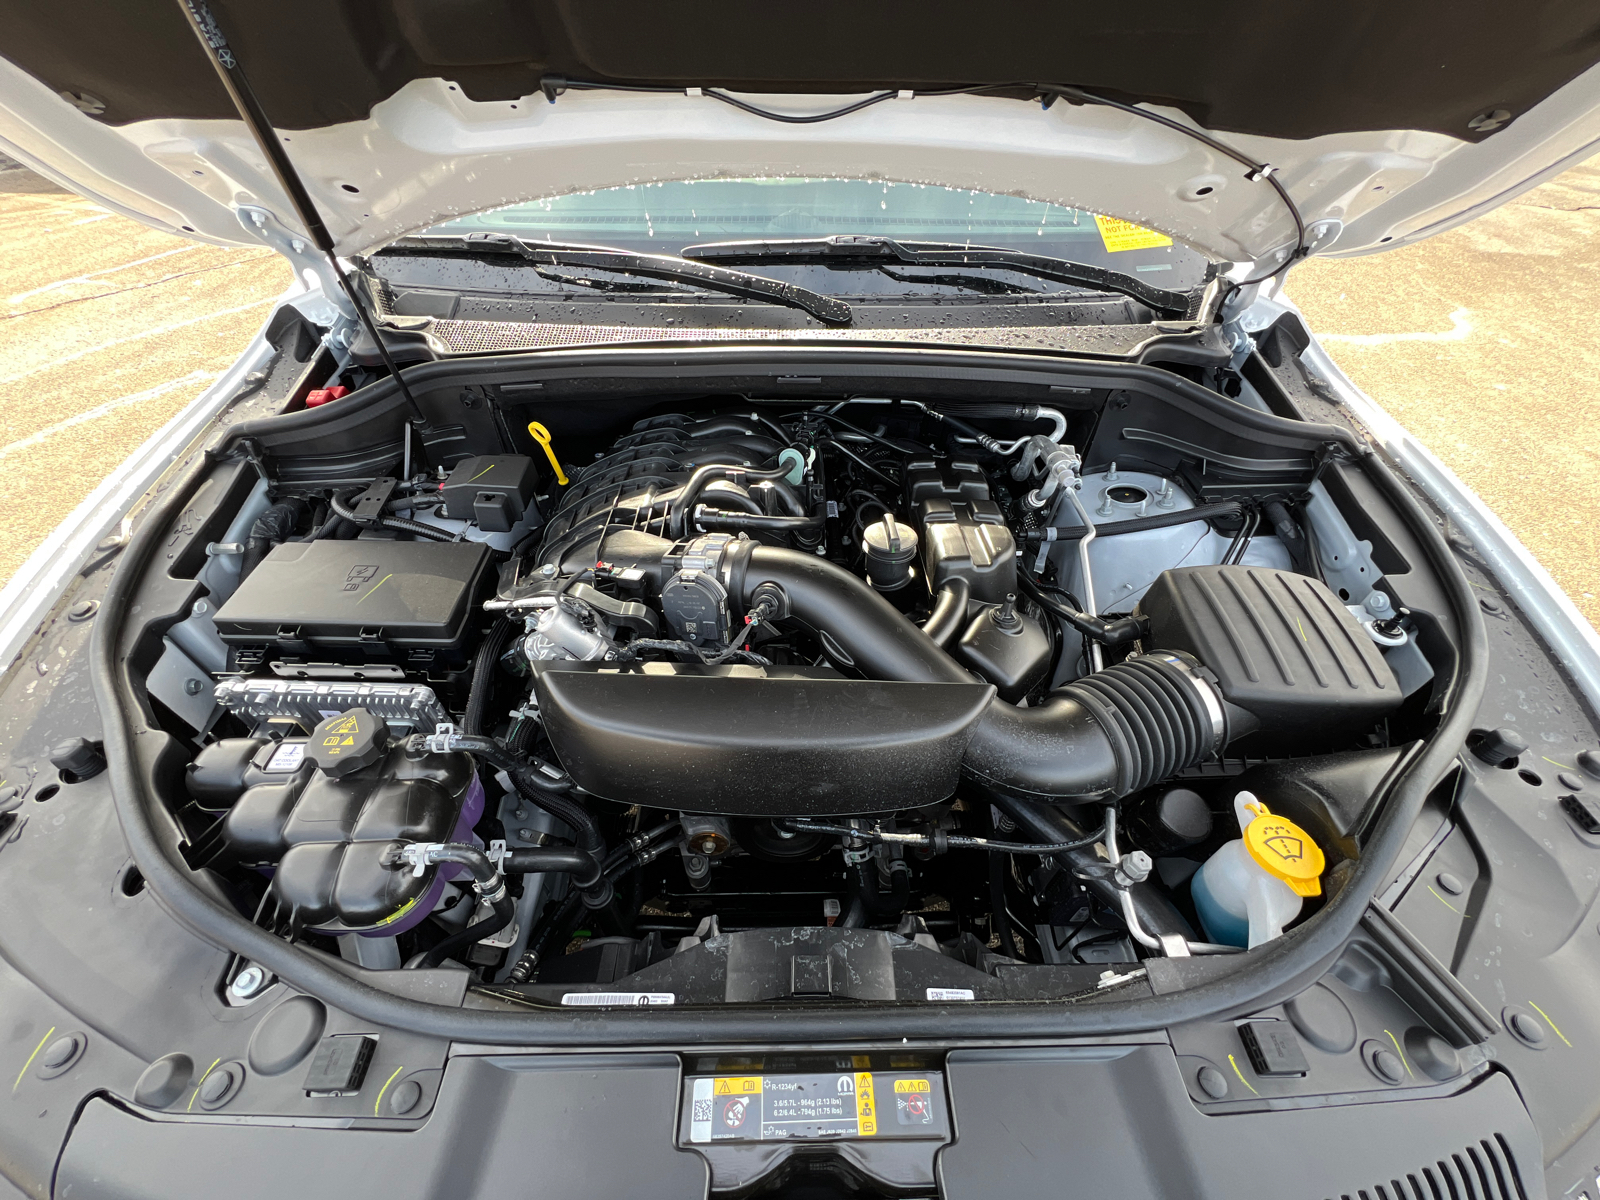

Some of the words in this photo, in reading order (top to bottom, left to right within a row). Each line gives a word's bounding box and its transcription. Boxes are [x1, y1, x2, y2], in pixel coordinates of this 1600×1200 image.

[1105, 225, 1122, 234] NOT
[771, 1083, 797, 1091] R-1234yf
[773, 1099, 797, 1107] 3.6/5.7L
[816, 1098, 830, 1106] (2.13
[830, 1097, 842, 1106] lbs)
[773, 1108, 797, 1117] 6.2/6.4L
[816, 1107, 831, 1116] (1.75
